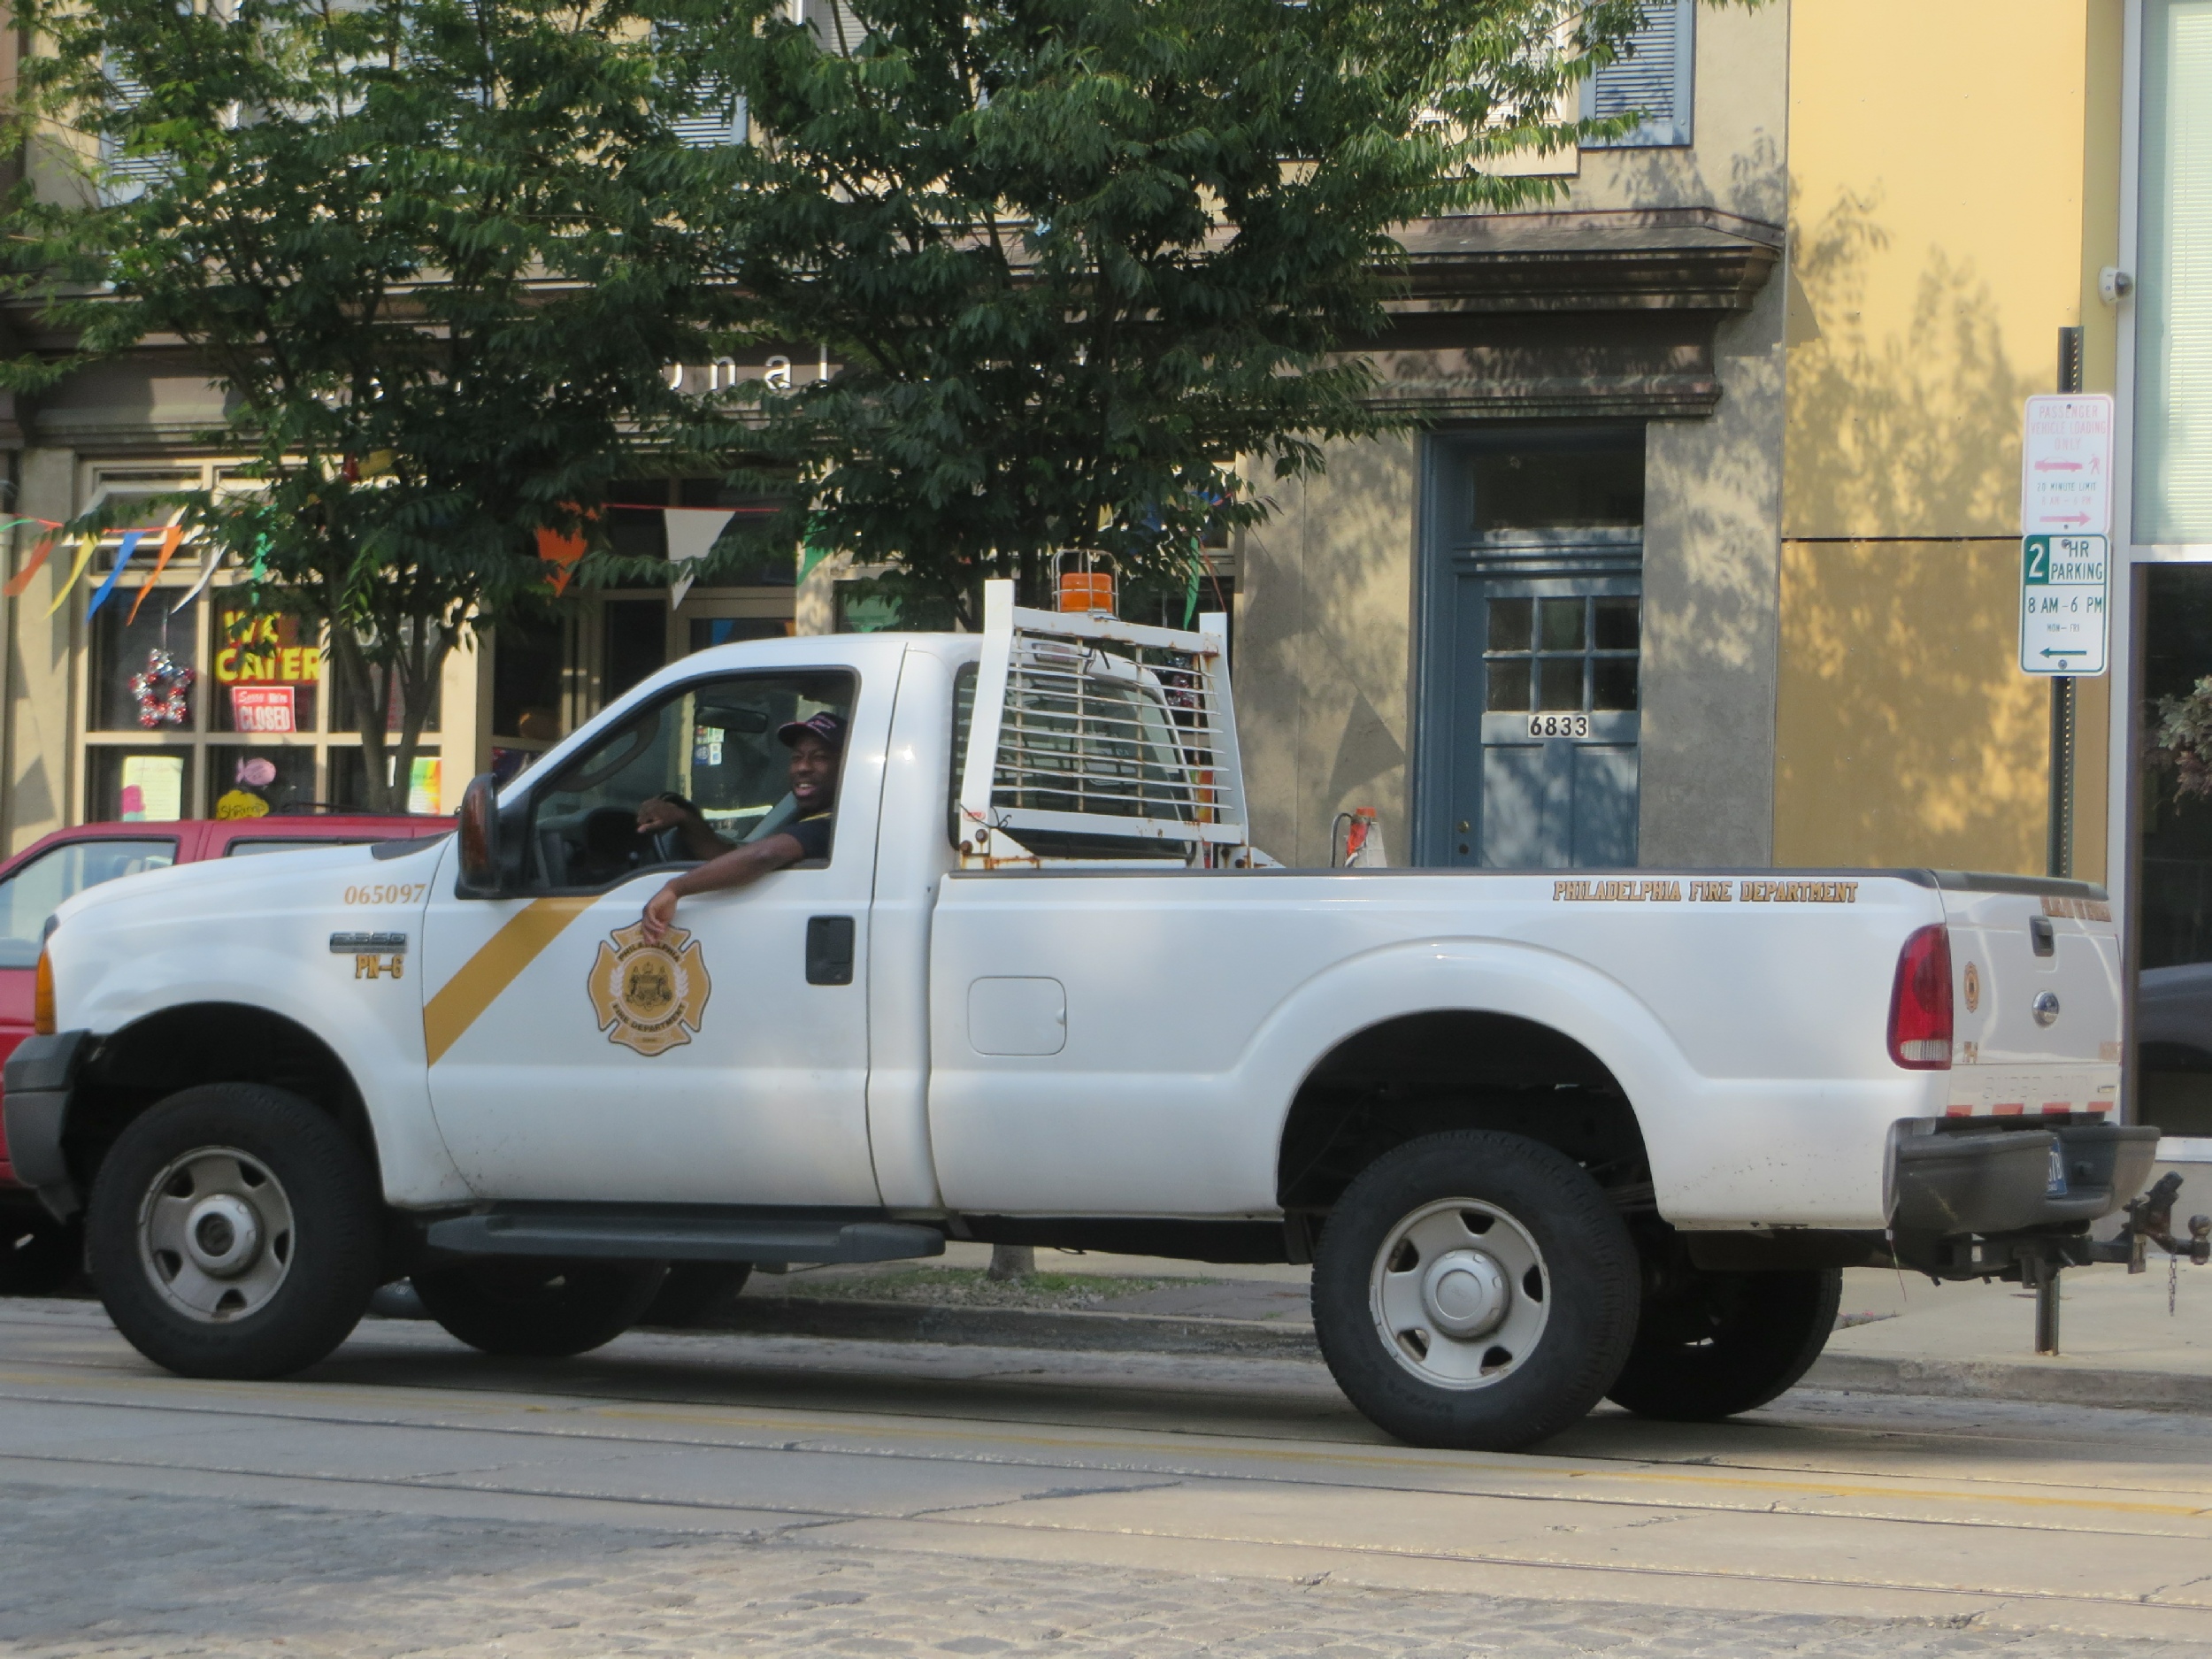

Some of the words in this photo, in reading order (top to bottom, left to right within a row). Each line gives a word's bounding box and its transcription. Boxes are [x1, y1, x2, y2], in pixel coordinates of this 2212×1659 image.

[2039, 404, 2099, 419] PASSENGER
[2031, 421, 2066, 435] VEHICLE
[2070, 420, 2107, 434] LOADING
[2055, 437, 2081, 451] ONLY
[2037, 482, 2047, 492] 20
[2050, 482, 2075, 492] MINUTE
[2078, 482, 2096, 492] LIMIT
[2049, 496, 2060, 506] AM
[2082, 495, 2092, 505] PM
[2028, 543, 2045, 578] 2
[2069, 540, 2089, 558] HR
[2050, 562, 2103, 580] PARKING
[2028, 596, 2036, 614] 8
[2040, 596, 2059, 614] AM
[2070, 595, 2078, 613] 6
[2086, 596, 2102, 614] PM
[215, 647, 320, 681] CATER
[240, 705, 291, 730] CLOSED
[1530, 716, 1587, 736] 6833
[344, 883, 426, 905] 065097
[1553, 880, 1682, 902] PHILADELPHIA
[1688, 880, 1732, 902] FIRE
[1740, 881, 1859, 903] DEPARTMENT
[630, 1001, 686, 1033] DEPARTMENT
